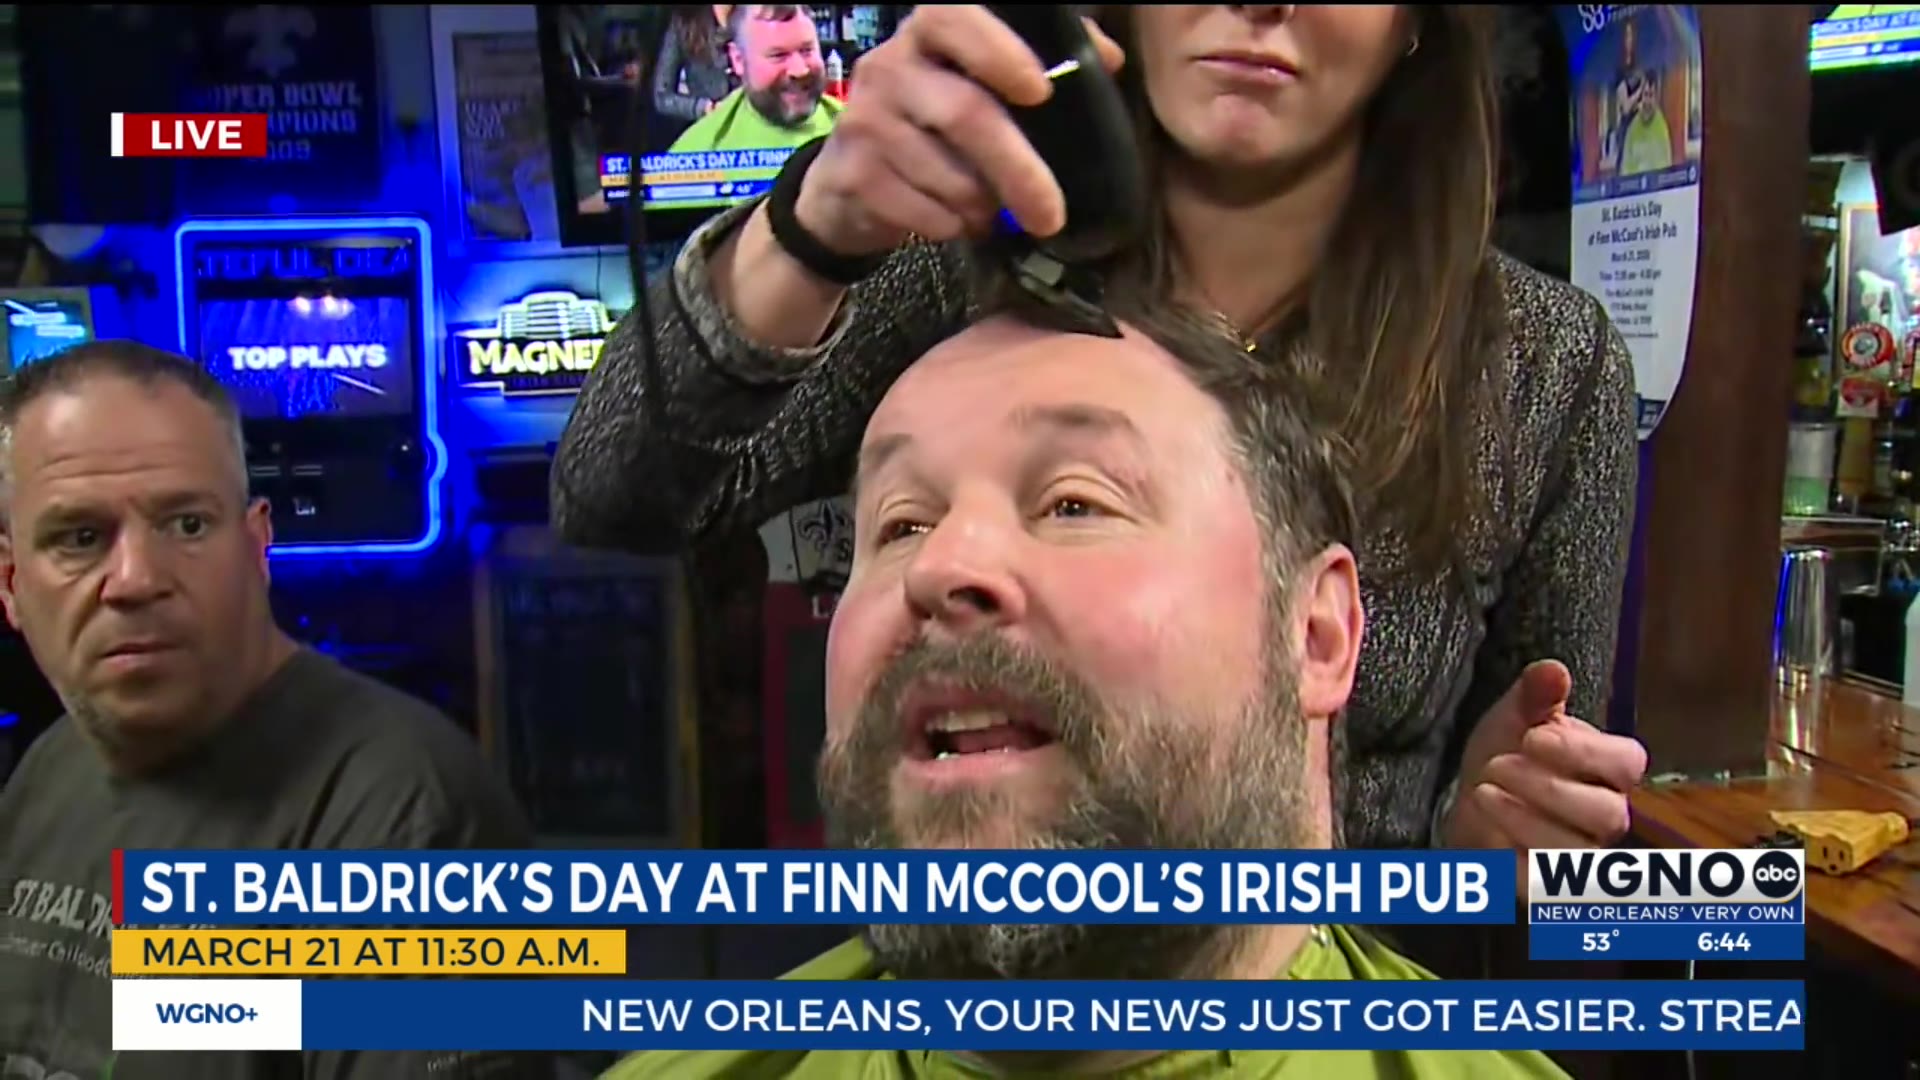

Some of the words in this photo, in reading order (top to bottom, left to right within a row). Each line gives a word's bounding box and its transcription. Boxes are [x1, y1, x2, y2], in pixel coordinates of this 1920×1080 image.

[629, 153, 706, 172] ALDRICK'S
[708, 151, 738, 167] DAY
[738, 150, 756, 166] AT
[228, 346, 287, 370] TOP
[291, 345, 387, 369] PLAYS
